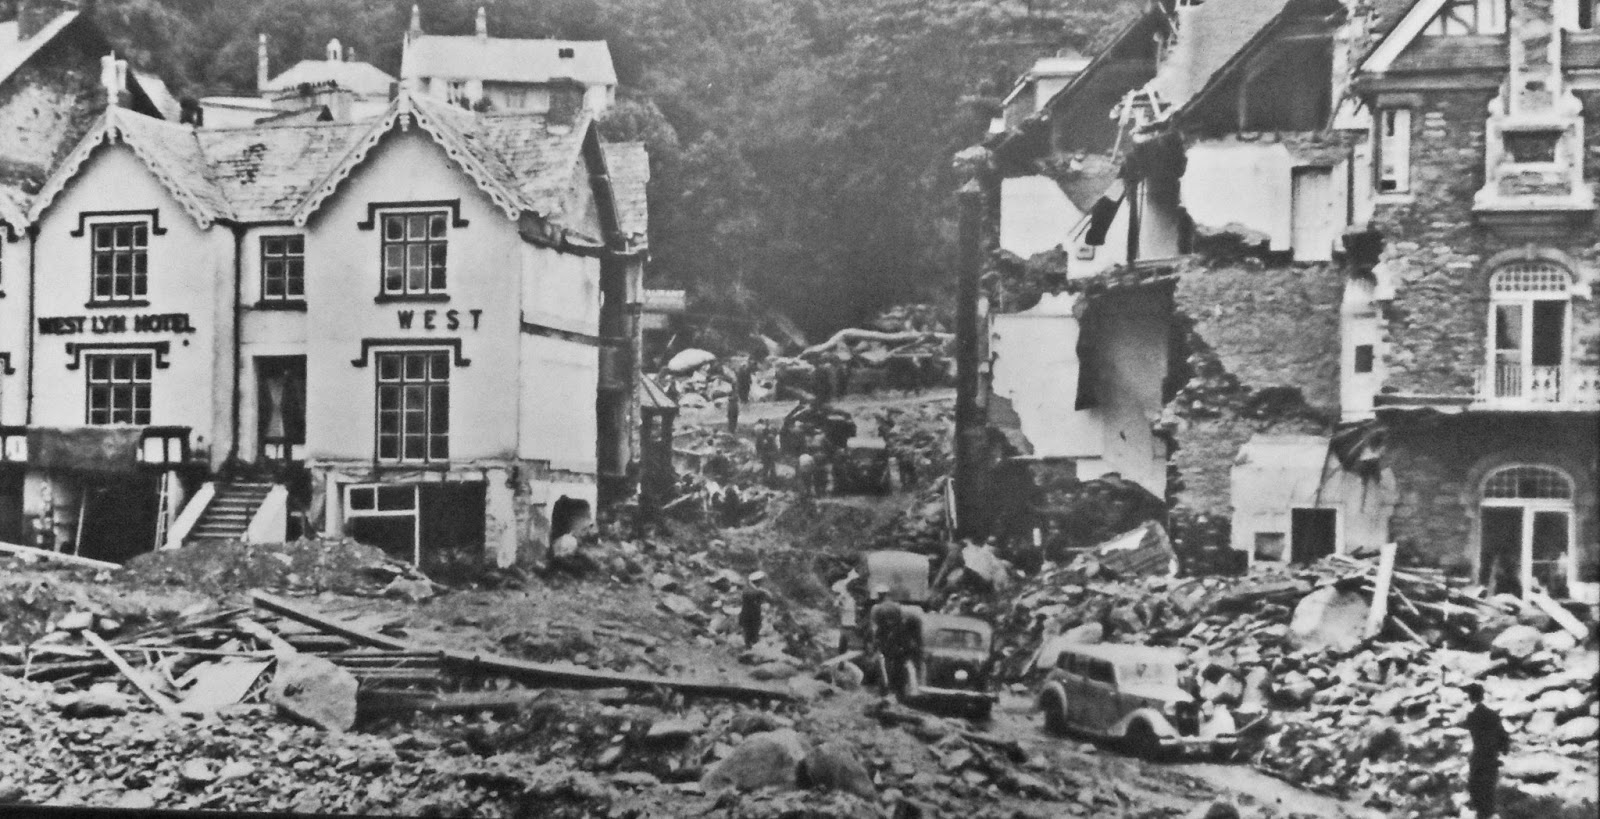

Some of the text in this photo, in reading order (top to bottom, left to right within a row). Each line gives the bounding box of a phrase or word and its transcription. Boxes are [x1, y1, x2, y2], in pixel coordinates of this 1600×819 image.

[38, 313, 196, 334] WEST LYN HOTEL
[397, 309, 482, 330] WEST
